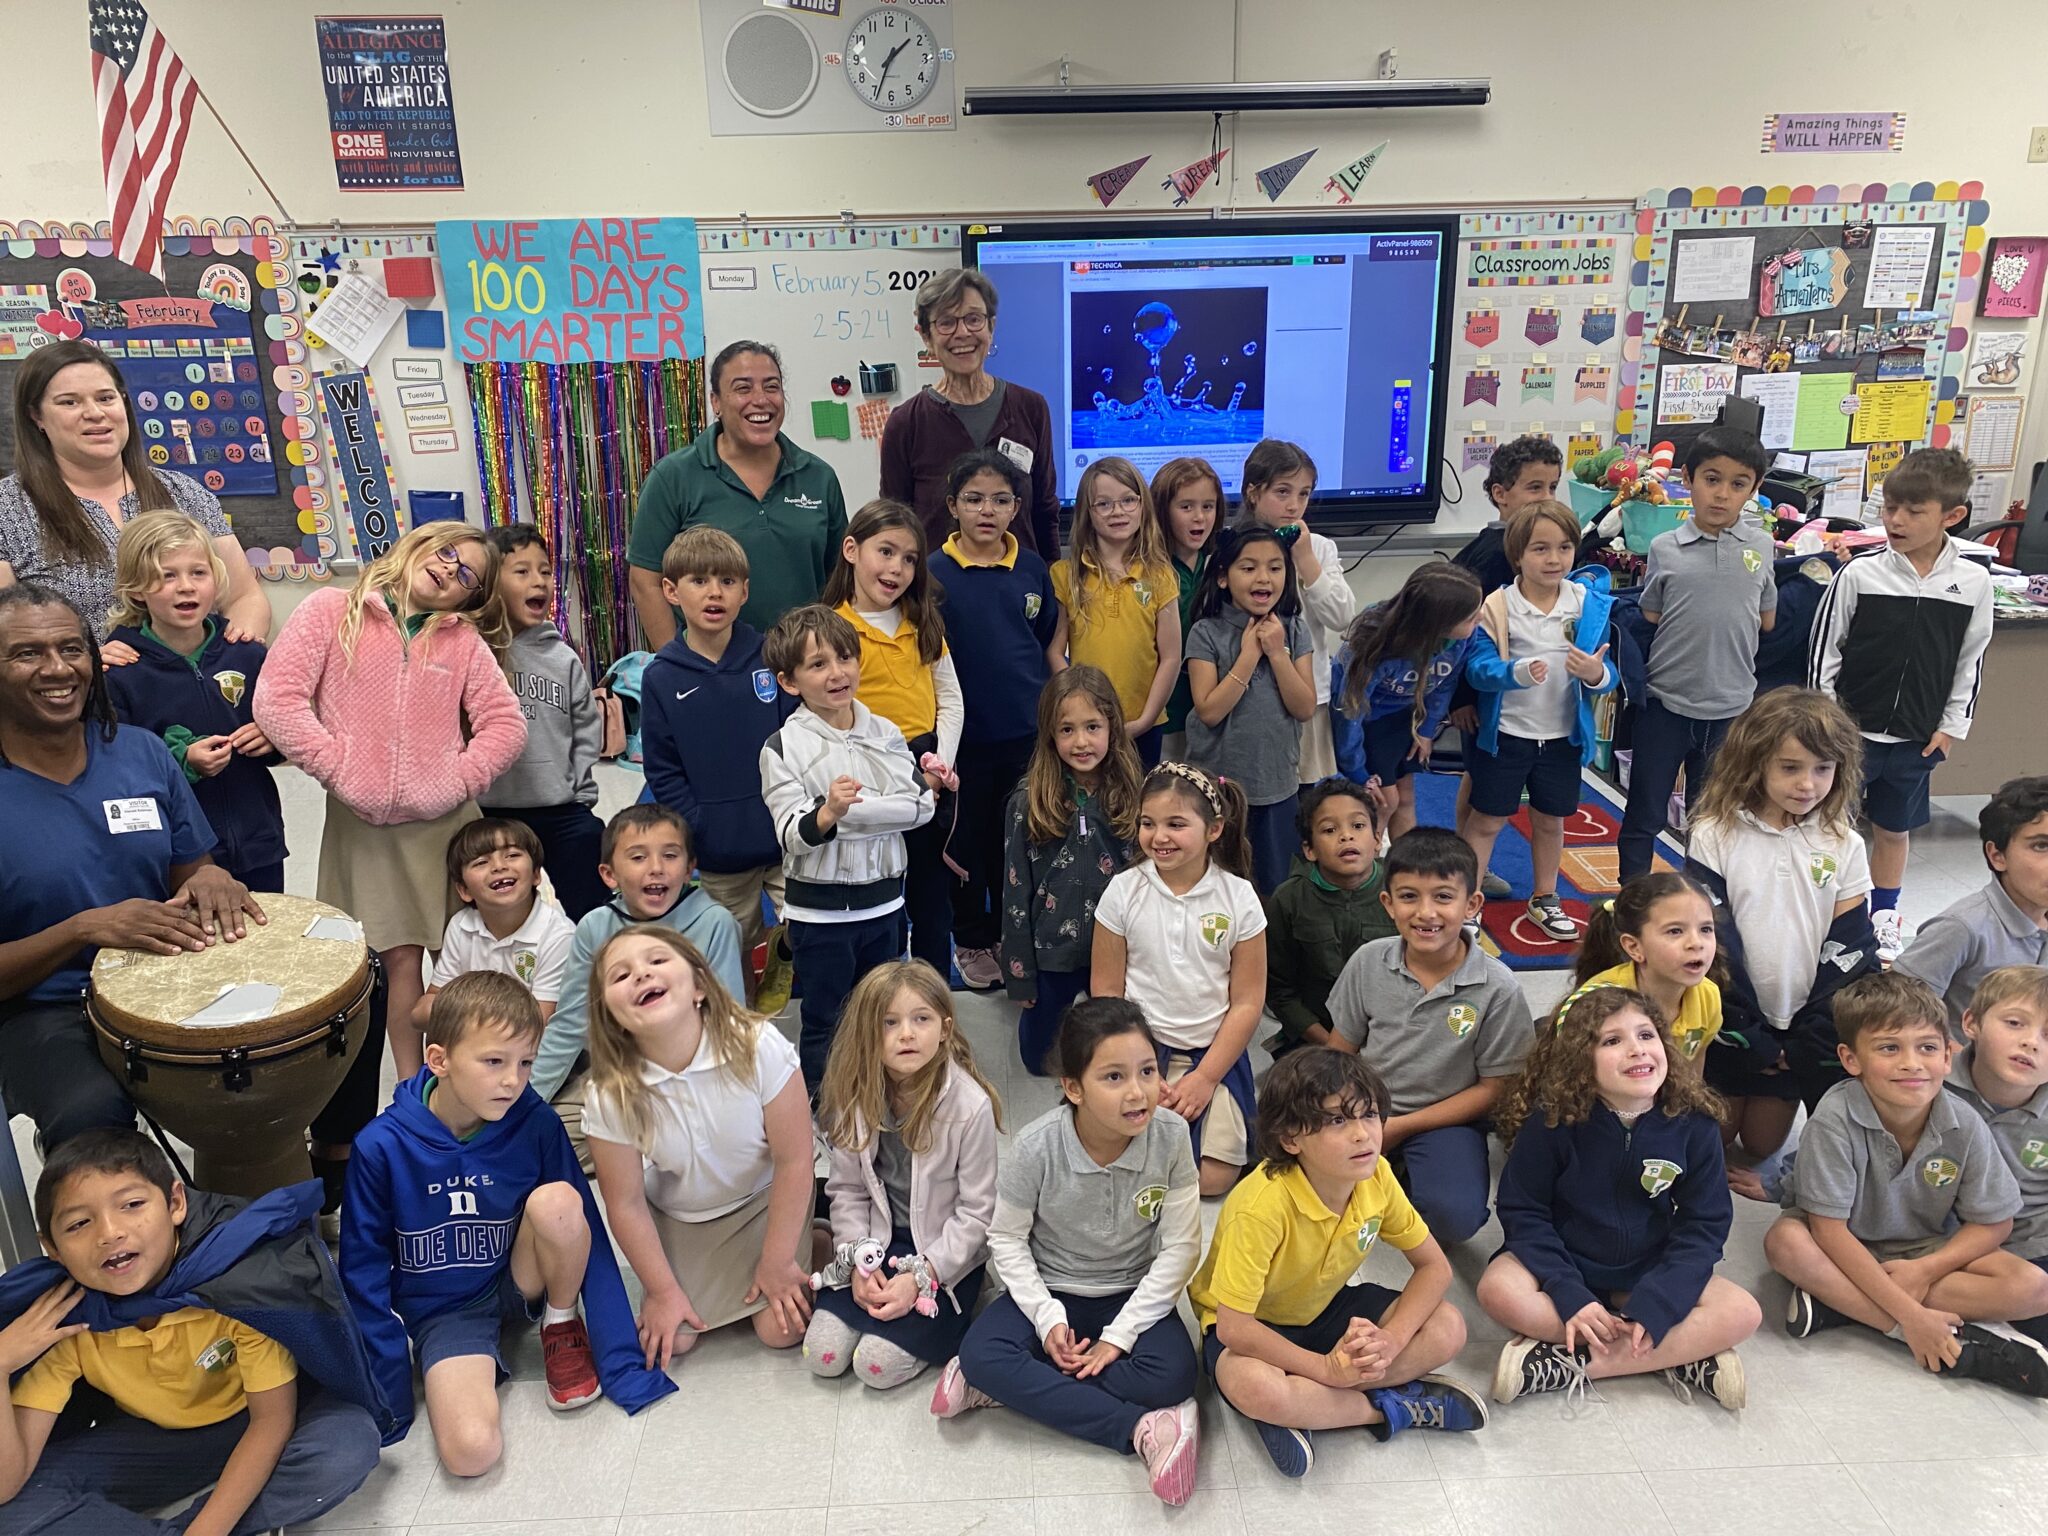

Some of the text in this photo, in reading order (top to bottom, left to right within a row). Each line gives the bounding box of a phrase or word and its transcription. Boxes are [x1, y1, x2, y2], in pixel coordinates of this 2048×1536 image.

[867, 20, 878, 33] 11
[884, 15, 895, 28] 12
[904, 21, 910, 33] 1
[323, 34, 443, 49] ALLEGIANCE
[916, 35, 923, 46] 2
[327, 52, 335, 60] to
[337, 51, 350, 60] the
[353, 51, 411, 64] FLAG
[413, 55, 426, 63] OF
[824, 55, 841, 65] :45
[853, 55, 860, 65] 9
[921, 53, 930, 64] 3
[939, 50, 953, 60] :15
[326, 65, 446, 84] UNITED STATES
[858, 72, 865, 83] 8
[917, 72, 924, 83] 4
[363, 84, 448, 108] AMERICA
[871, 85, 878, 97] 7
[888, 90, 895, 102] 6
[905, 85, 911, 96] 5
[334, 110, 451, 121] AND TO THE REPUBLIC
[885, 114, 950, 127] :30 half past
[335, 121, 452, 131] for which it stands
[1786, 118, 1883, 131] Amazing Things
[337, 134, 383, 148] ONE
[1784, 132, 1883, 147] WILL HAPPEN
[338, 148, 456, 158] NATION INDIVISIBLE
[403, 161, 421, 173] and
[1338, 153, 1376, 193] LEARN
[403, 176, 430, 184] for
[472, 217, 666, 264] WE ARE
[1376, 239, 1433, 249] ActivPanel-986509
[2004, 244, 2035, 254] LOVE U
[1091, 261, 1123, 270] TECHNICA
[1474, 252, 1611, 275] Classroom Jobs
[1795, 256, 1824, 279] Mrs.
[67, 278, 79, 287] Be
[205, 270, 218, 289] Today
[228, 269, 243, 284] Your
[718, 275, 746, 284] Monday
[772, 263, 861, 297] February
[888, 271, 937, 292] 202
[467, 259, 689, 314] 100 DAYS
[1775, 281, 1835, 309] Armenteros
[4, 310, 37, 320] WINTE
[136, 301, 201, 323] February
[8, 326, 38, 334] WEATHER
[1472, 326, 1493, 334] LIGHTS
[461, 312, 688, 364] SMARTER
[406, 364, 429, 375] Friday
[1525, 380, 1552, 390] CALENDAR
[1579, 381, 1606, 390] SUPPLIES
[1664, 376, 1734, 392] FIRST DAY
[406, 389, 436, 400] Tuesday
[143, 396, 153, 408] 6
[169, 396, 178, 407] 7
[196, 395, 204, 405] 8
[408, 412, 448, 423] Wednesday
[148, 423, 161, 435] 13
[249, 421, 260, 432] 17
[417, 437, 449, 448] Thursday
[151, 449, 167, 460] 20
[228, 448, 242, 459] 23
[252, 446, 266, 458] 24
[1573, 448, 1594, 457] PAPERS
[1871, 451, 1898, 462] Be KIND
[207, 474, 222, 486] 29
[528, 673, 570, 715] SOLEIL
[428, 1174, 491, 1195] DUKE
[396, 1229, 447, 1268] LUE
